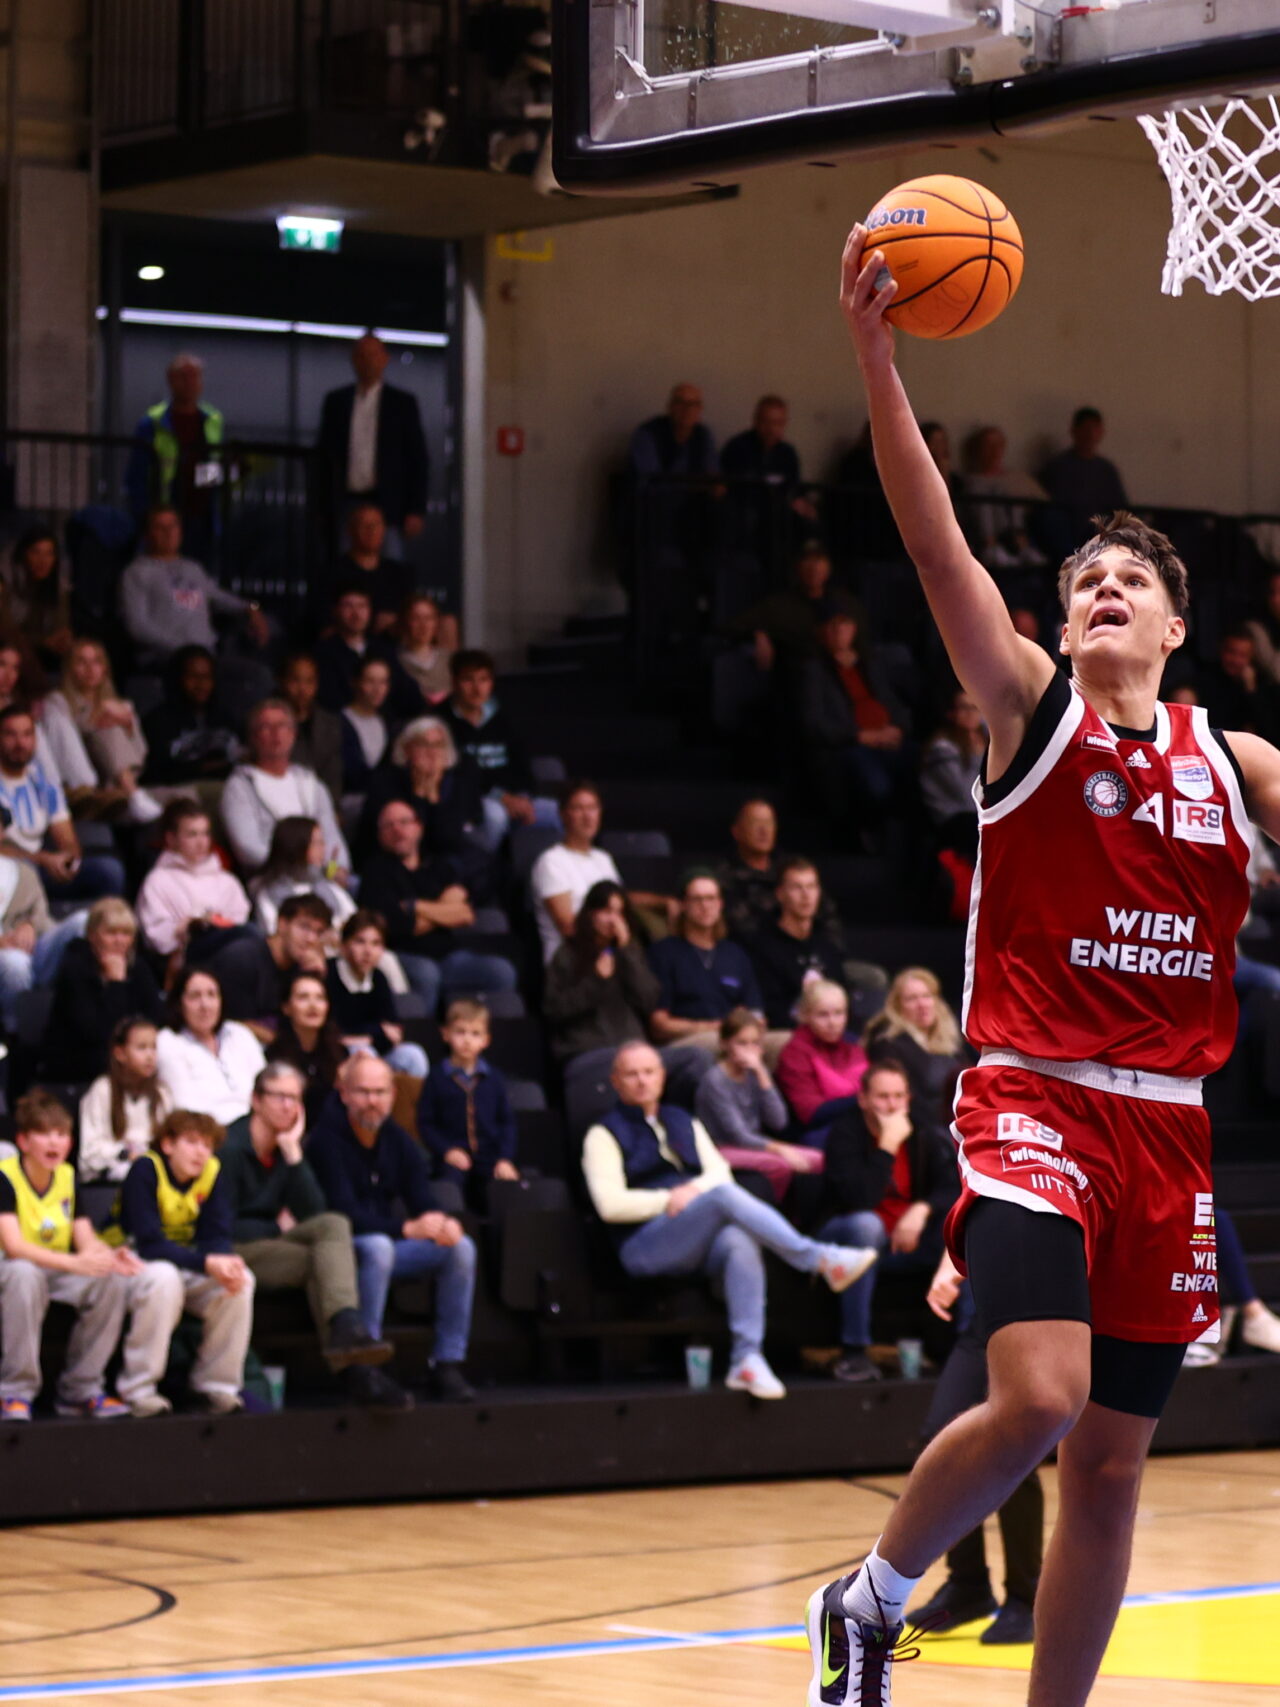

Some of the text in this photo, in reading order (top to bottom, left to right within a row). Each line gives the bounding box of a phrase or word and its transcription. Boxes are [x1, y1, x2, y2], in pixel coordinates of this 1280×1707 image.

[1105, 905, 1196, 944] WIEN
[1069, 937, 1214, 981] ENERGIE
[1192, 1251, 1217, 1270] WIE
[1170, 1272, 1218, 1293] ENER
